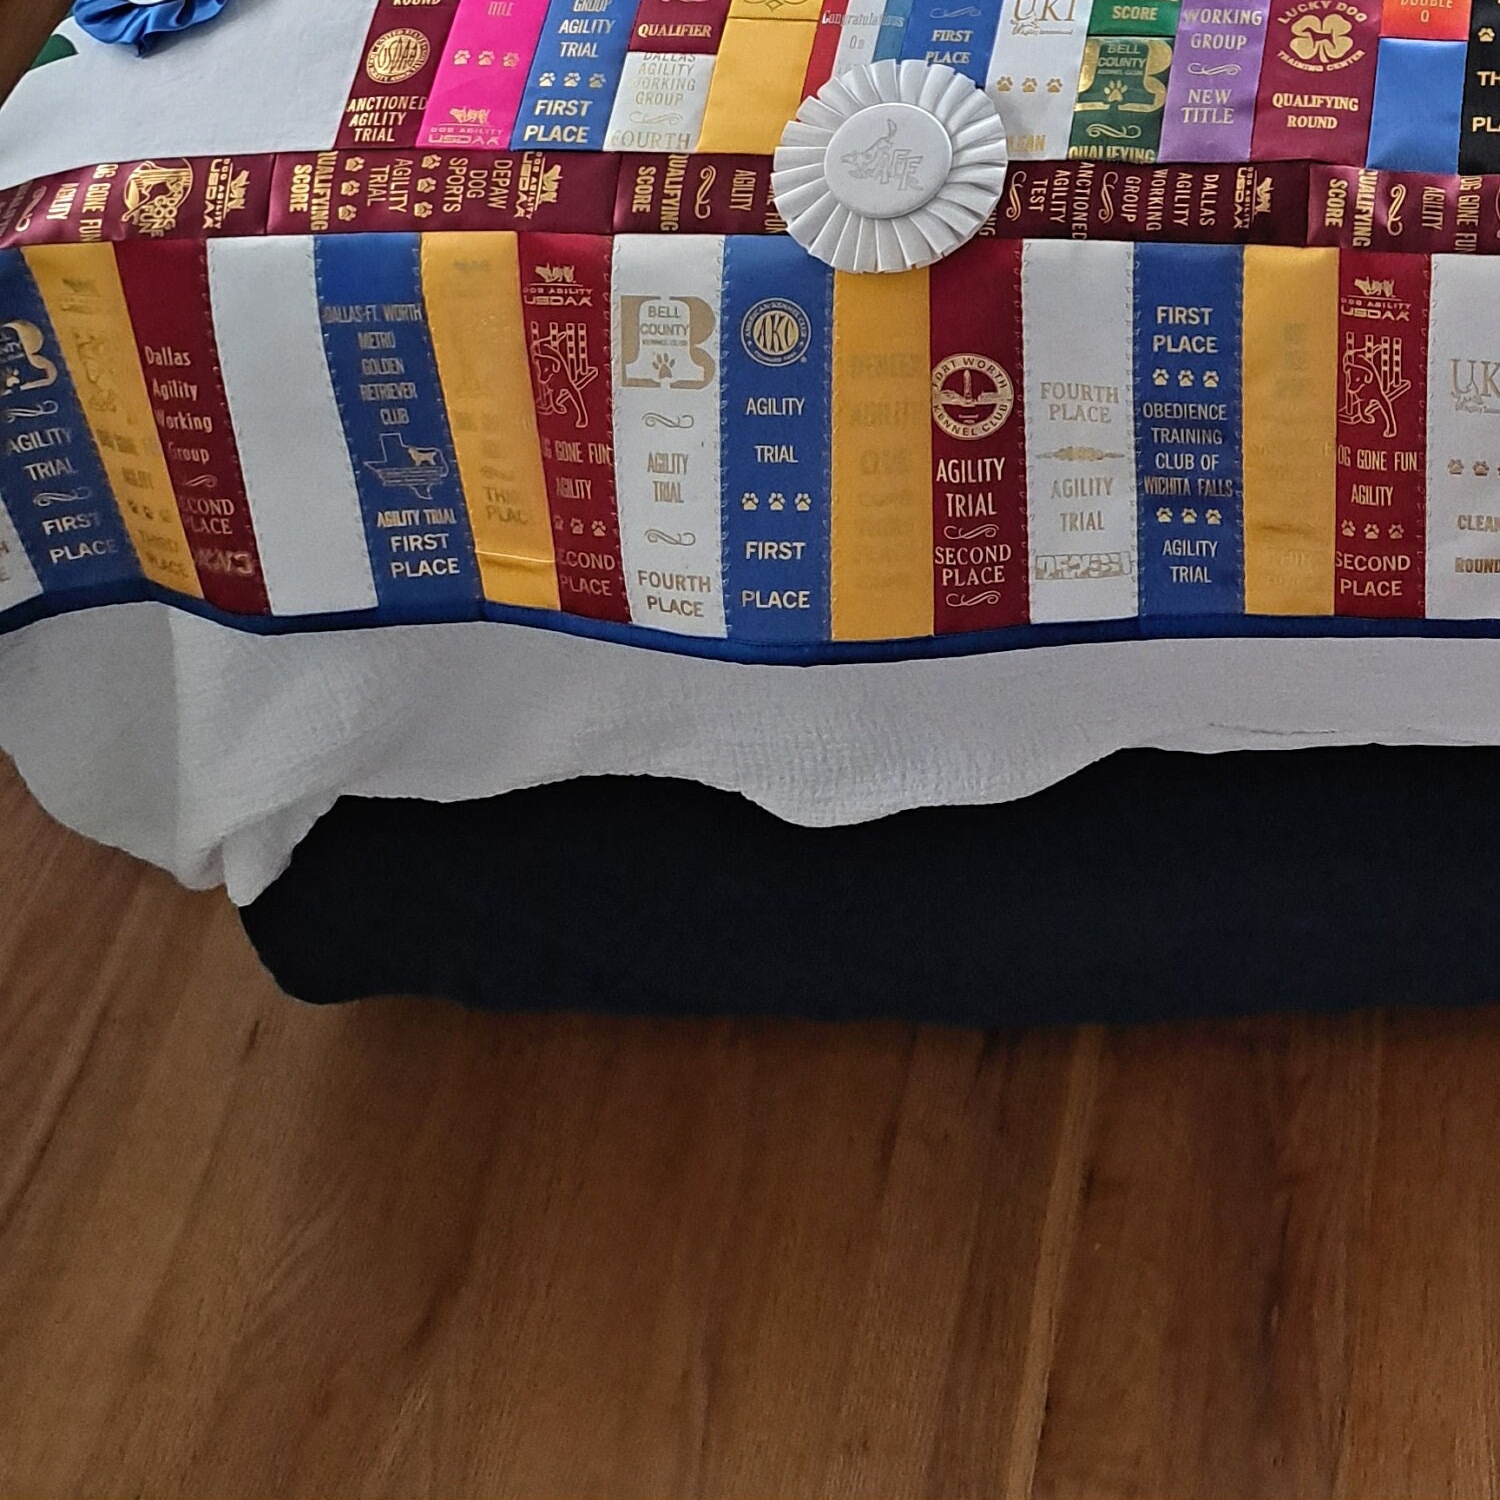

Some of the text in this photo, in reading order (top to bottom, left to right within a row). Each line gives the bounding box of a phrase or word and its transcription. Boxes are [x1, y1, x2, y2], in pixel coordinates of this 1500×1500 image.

[1183, 9, 1262, 26] WORKING
[1277, 0, 1332, 24] LUCKY
[637, 24, 712, 38] QUALIFIER
[1190, 34, 1248, 50] GROUP
[1188, 88, 1232, 104] NEW
[1272, 92, 1359, 112] QUALIFYING
[533, 100, 593, 117] FIRST
[1180, 107, 1234, 124] TITLE
[1286, 116, 1338, 130] ROUND
[523, 126, 590, 143] PLACE
[288, 163, 312, 213] SCORE
[366, 165, 390, 207] TRIAL
[390, 157, 414, 213] AGILITY
[443, 156, 468, 213] SPORTS
[467, 169, 487, 199] DOG
[487, 160, 513, 209] DEPAW
[1120, 176, 1141, 222] GROUP
[1145, 168, 1168, 232] WORKING
[1172, 172, 1193, 228] AGILITY
[1199, 173, 1219, 227] DALLAS
[1324, 178, 1348, 228] SCORE
[648, 306, 680, 319] BELL
[640, 323, 691, 337] COUNTY
[752, 312, 799, 352] AKC
[144, 346, 192, 367] Dallas
[963, 357, 1008, 389] WORTH
[152, 379, 199, 403] Agility
[745, 397, 805, 416] AGILITY
[1143, 403, 1228, 421] OBEDIENCE
[933, 403, 1008, 436] KENNEL CLUB
[1151, 427, 1222, 445] TRAINING
[23, 457, 76, 482] TRIAL
[1155, 454, 1219, 470] CLUB OF
[1143, 476, 1234, 497] WICHITA FALLS
[390, 534, 449, 553] FIRST
[745, 541, 806, 560] FIRST
[934, 545, 1011, 565] SECOND
[390, 559, 460, 578] PLACE
[942, 566, 1006, 587] PLACE
[638, 571, 711, 592] FOURTH
[647, 597, 705, 618] PLACE
[742, 589, 811, 609] PLACE
